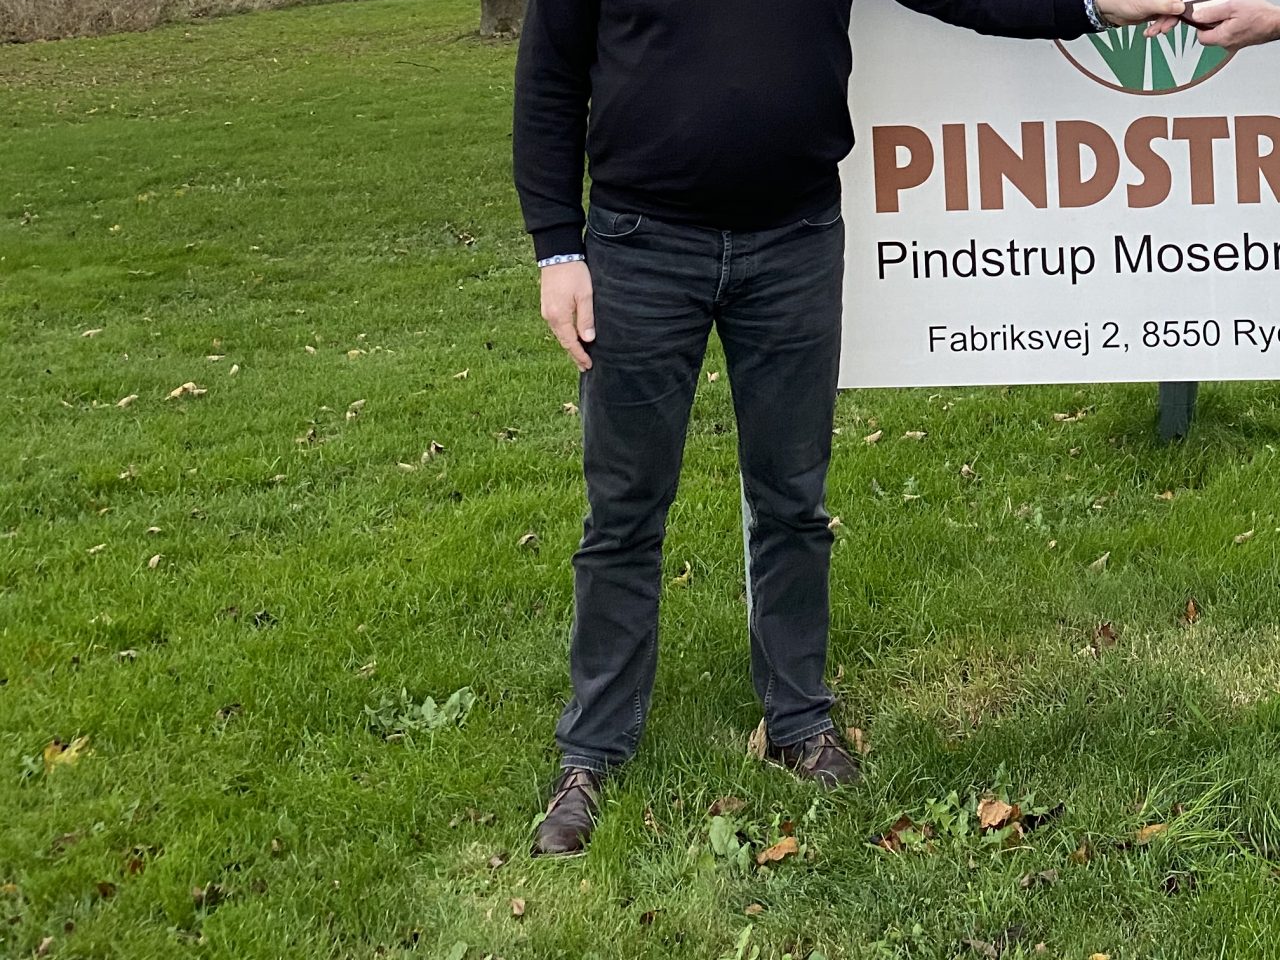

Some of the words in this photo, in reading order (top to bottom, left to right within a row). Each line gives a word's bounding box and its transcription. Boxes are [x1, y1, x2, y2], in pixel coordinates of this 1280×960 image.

[877, 239, 1095, 285] Pindstrup
[928, 323, 1091, 357] Fabriksvej
[1101, 321, 1130, 352] 2,
[1141, 320, 1221, 348] 8550
